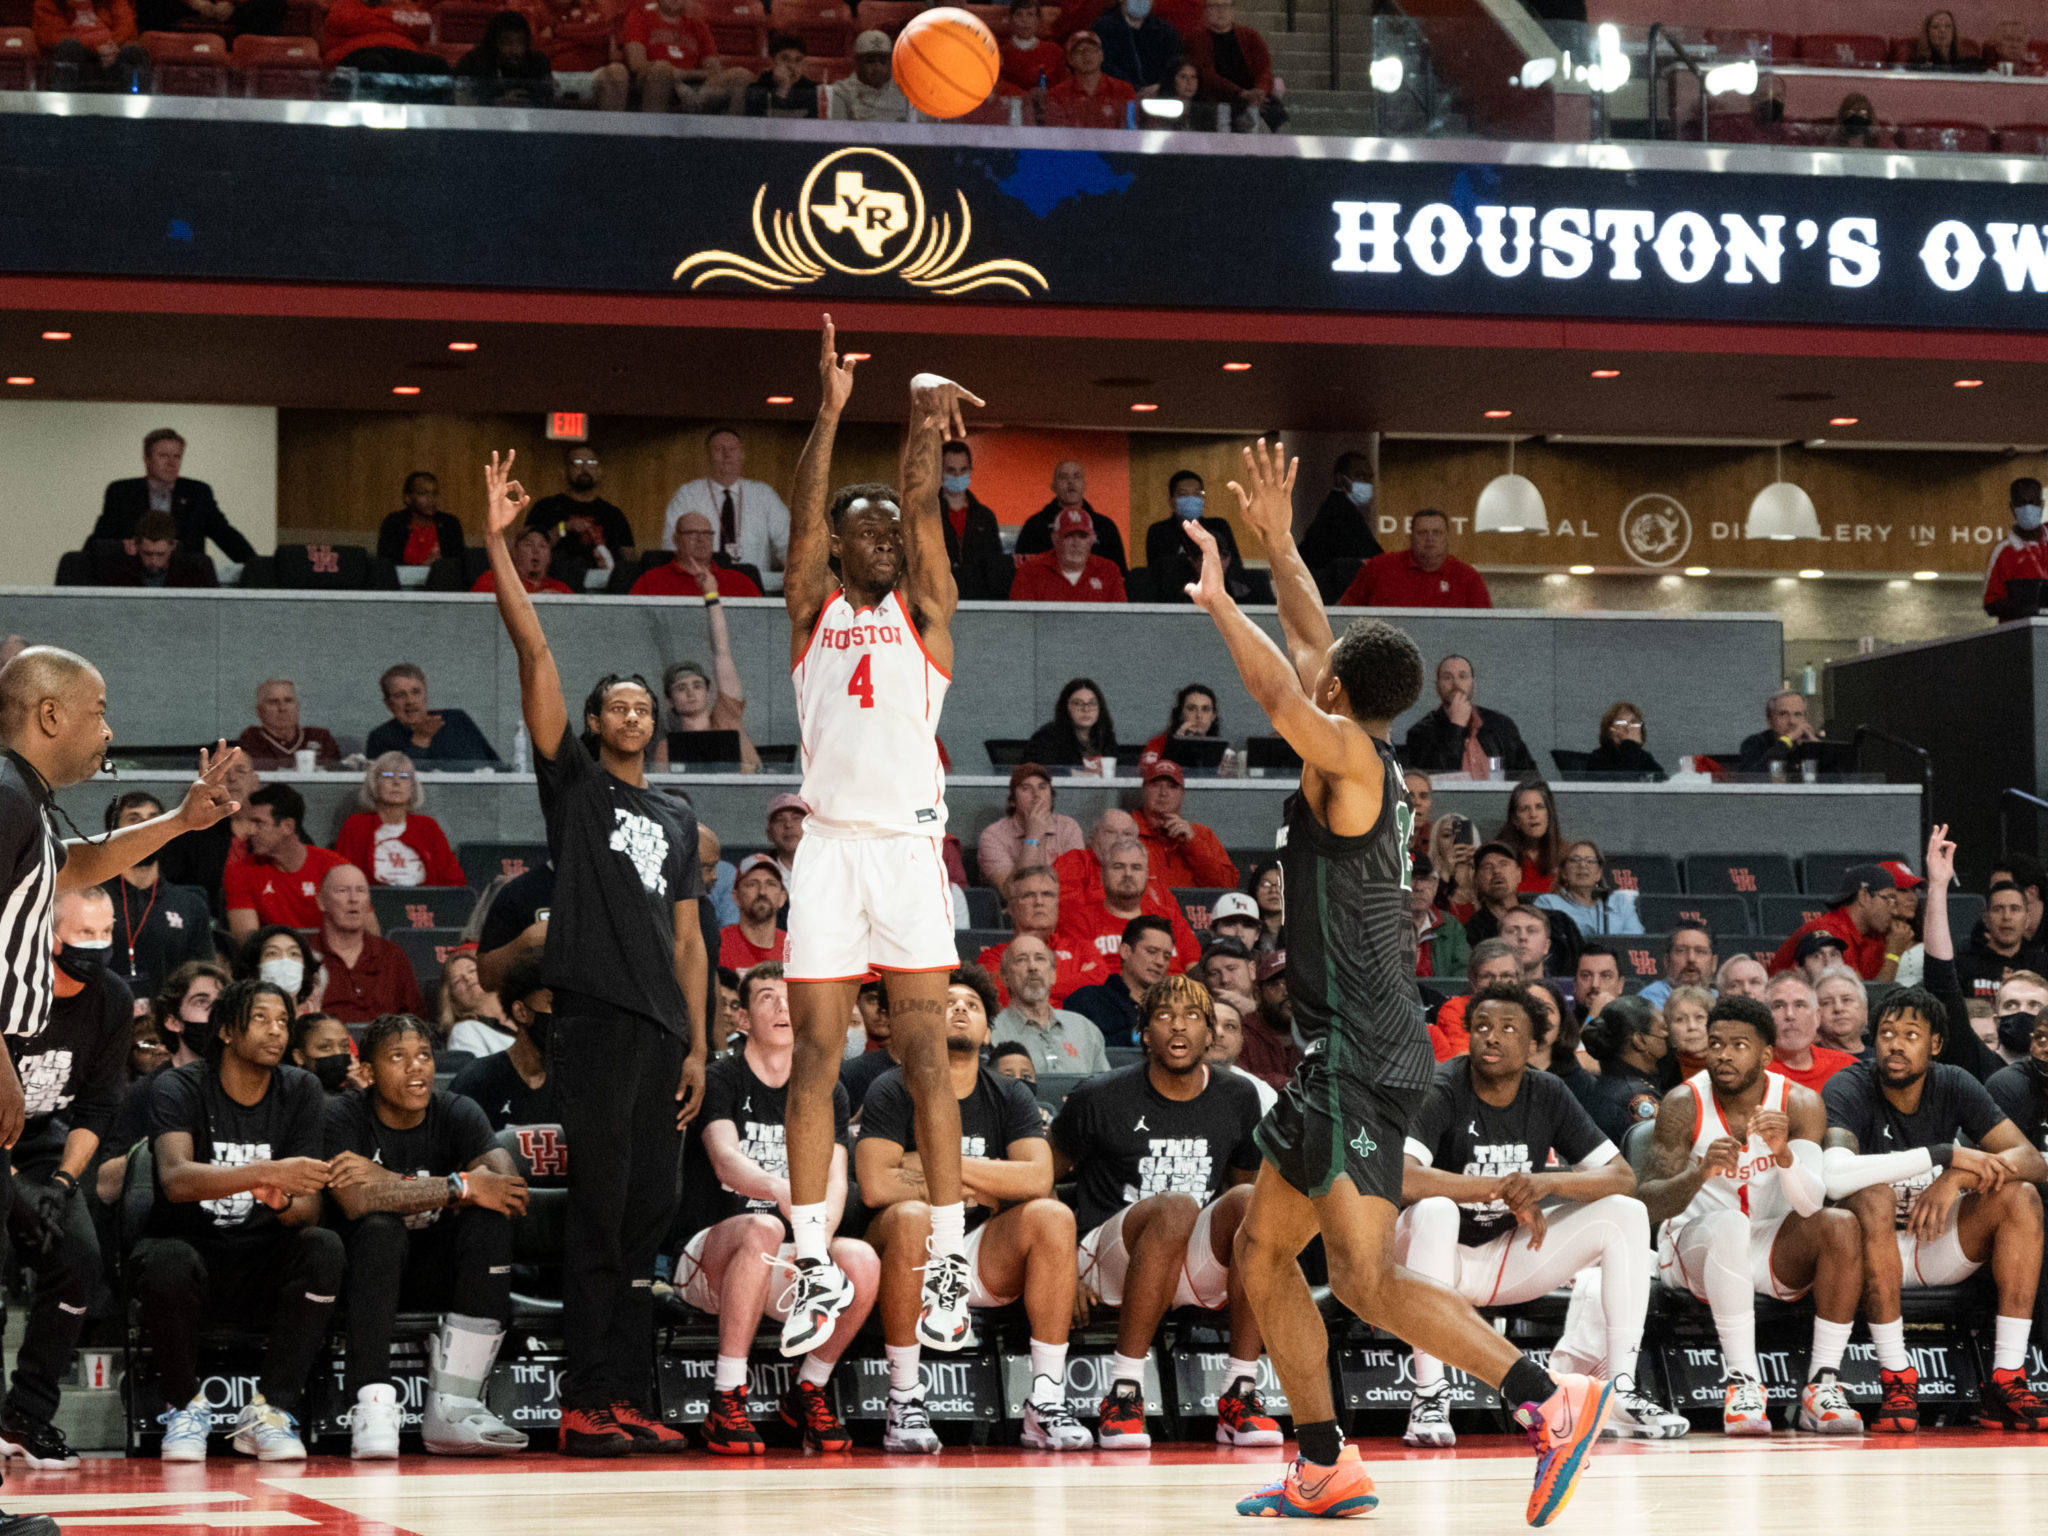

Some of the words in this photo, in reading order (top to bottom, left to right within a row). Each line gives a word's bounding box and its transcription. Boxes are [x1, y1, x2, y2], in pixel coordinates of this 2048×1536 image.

[840, 194, 893, 231] YR
[1331, 201, 1881, 288] HOUSTON'S
[552, 411, 585, 437] EXIT
[1910, 525, 1936, 541] IN
[820, 624, 903, 651] HOUSTON
[847, 653, 875, 709] 4
[1628, 949, 1658, 975] UH
[212, 1141, 272, 1162] THIS
[515, 1129, 568, 1176] UH
[1148, 1139, 1208, 1157] THIS
[1473, 1144, 1529, 1163] THIS
[1684, 1349, 1719, 1366] THE
[510, 1364, 547, 1384] THE
